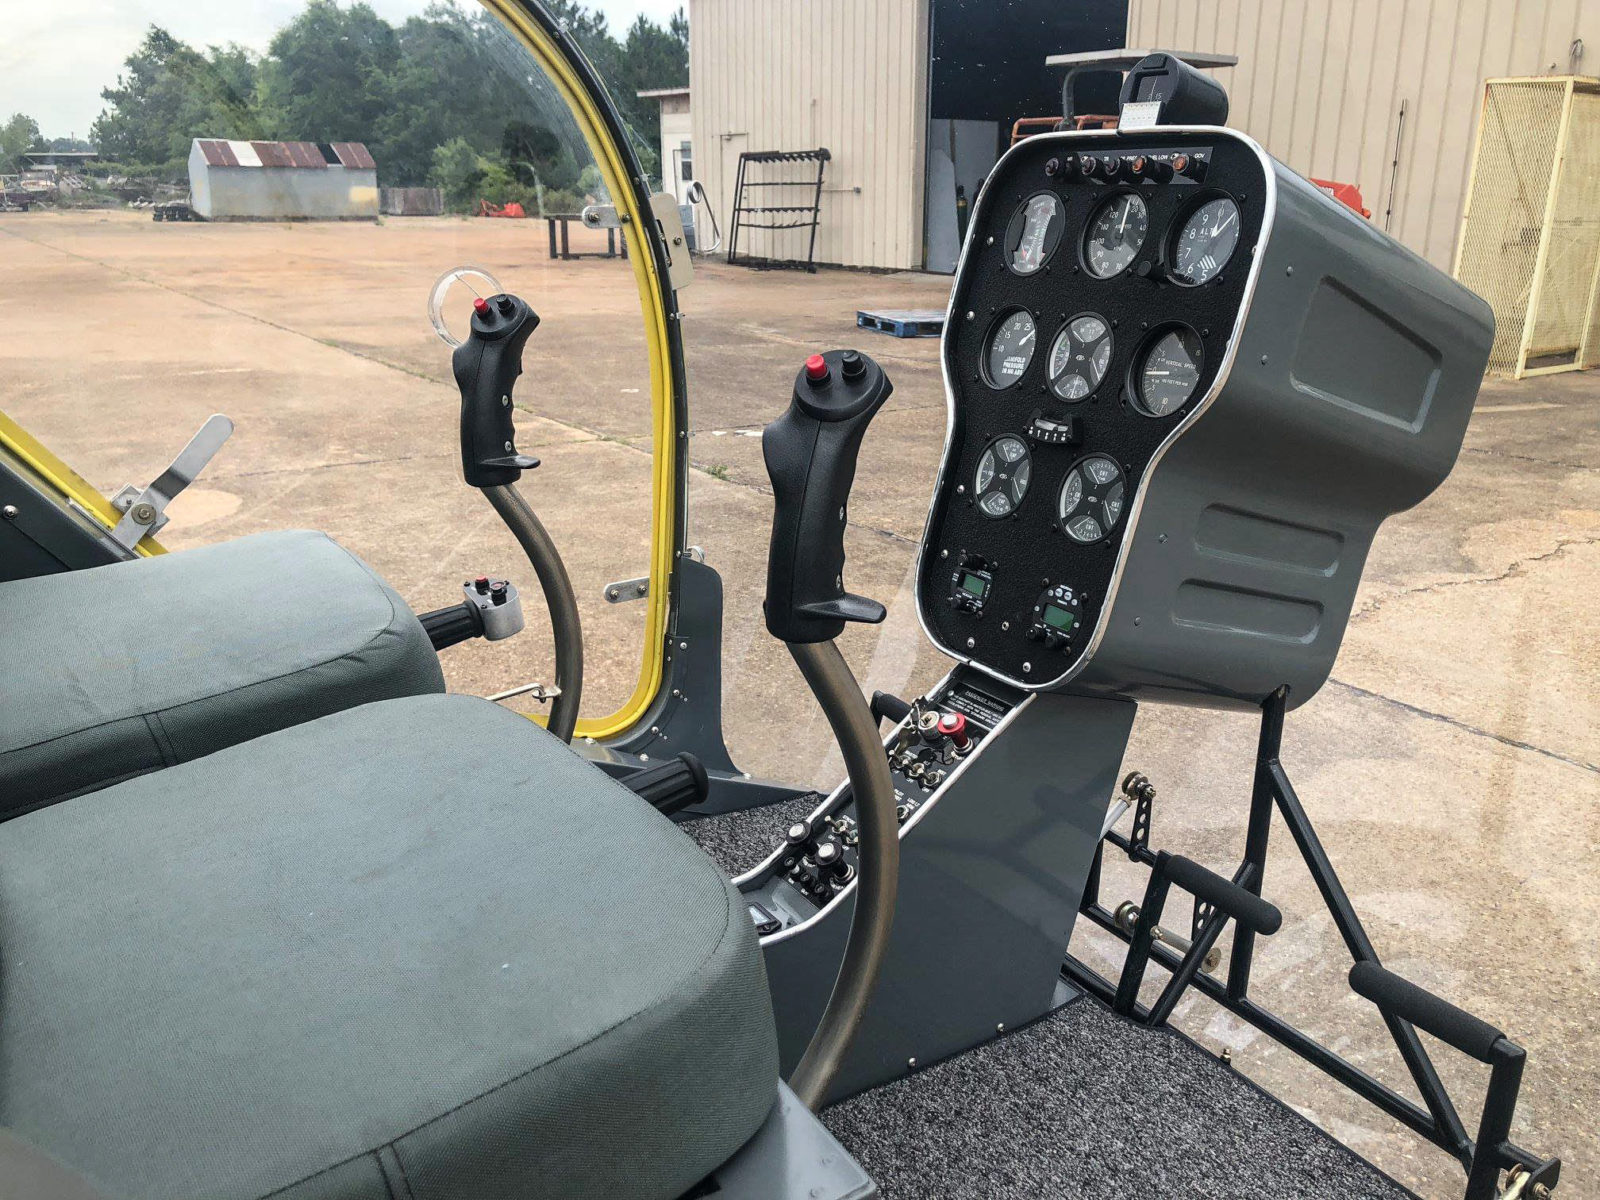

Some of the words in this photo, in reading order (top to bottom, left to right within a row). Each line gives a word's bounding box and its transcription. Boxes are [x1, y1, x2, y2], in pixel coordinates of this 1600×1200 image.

[1202, 214, 1208, 225] 9
[1190, 228, 1196, 239] 8
[1185, 248, 1191, 259] 7
[1188, 263, 1194, 273] 6
[1201, 270, 1208, 280] 5
